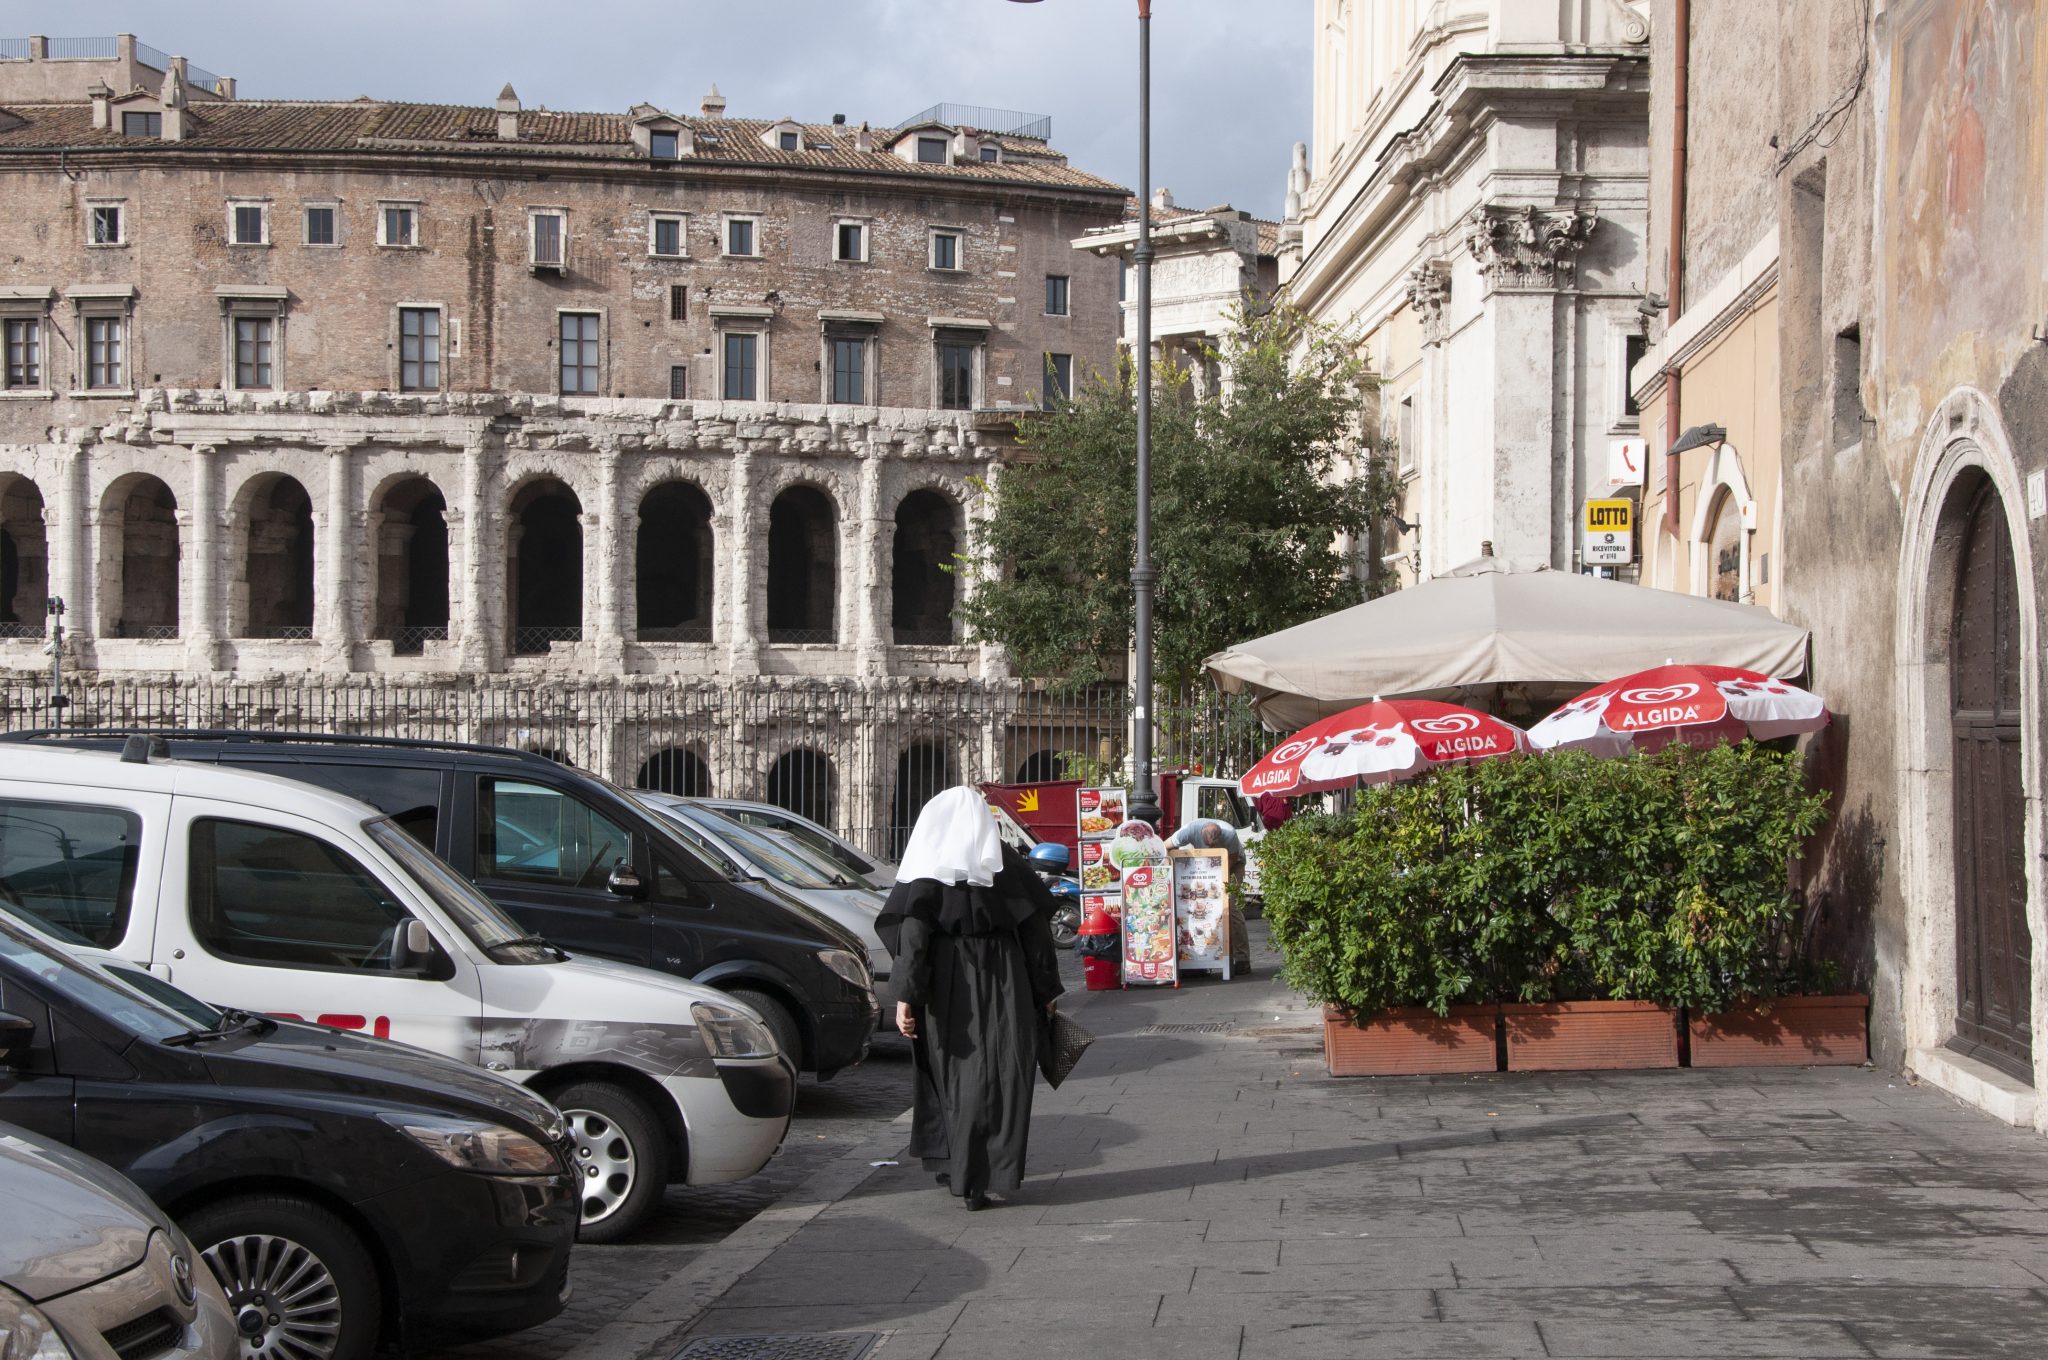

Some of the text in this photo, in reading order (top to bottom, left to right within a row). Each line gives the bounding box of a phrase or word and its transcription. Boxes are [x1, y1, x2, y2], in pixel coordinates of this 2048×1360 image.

[1590, 507, 1628, 525] LOTTO
[1622, 705, 1699, 727] ALGIDA
[1435, 735, 1497, 755] ALGIDA
[1252, 769, 1291, 788] ALGIDA
